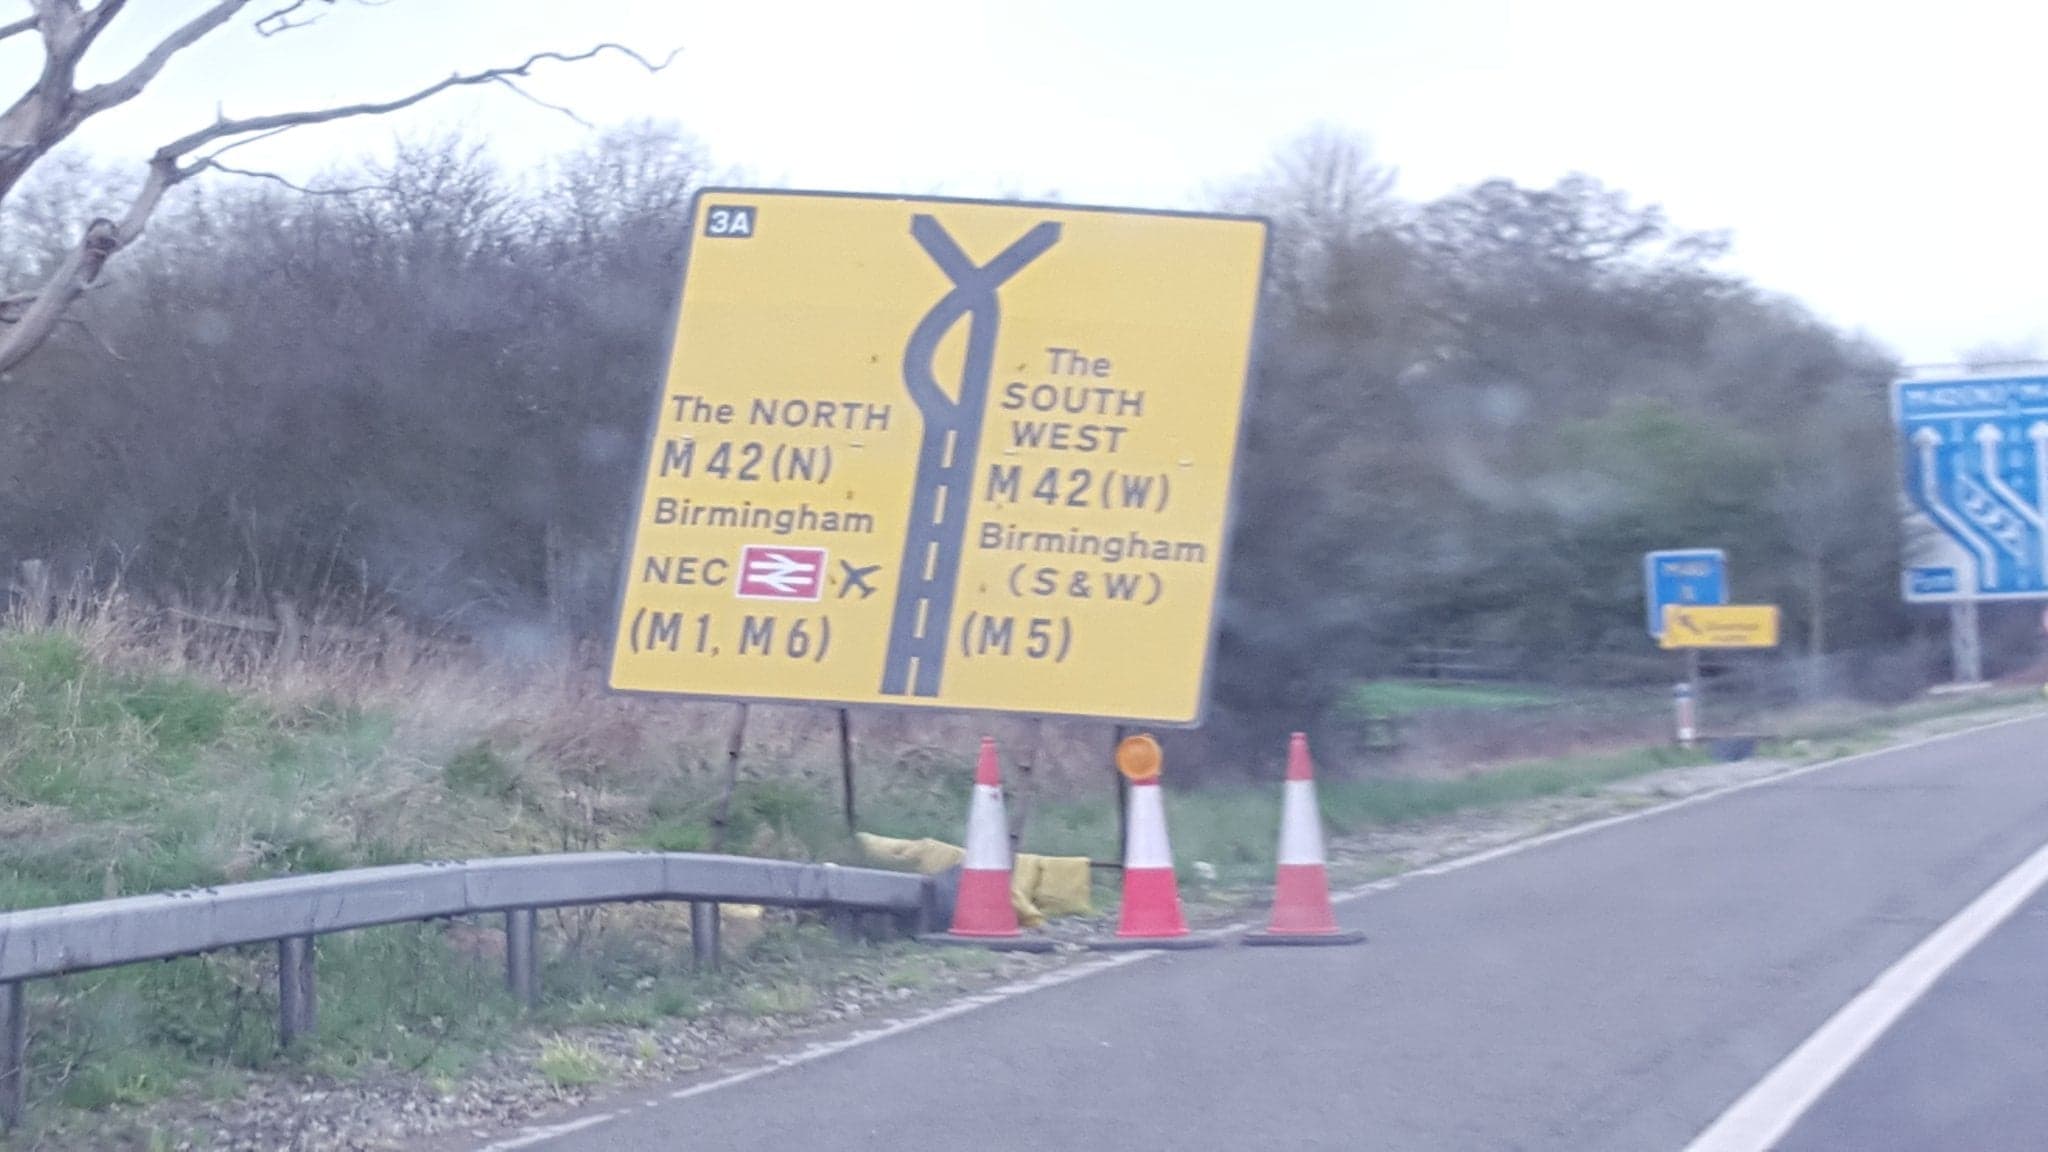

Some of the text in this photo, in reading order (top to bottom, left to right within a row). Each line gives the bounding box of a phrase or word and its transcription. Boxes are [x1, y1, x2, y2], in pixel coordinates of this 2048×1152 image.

[710, 210, 749, 234] 3A
[1046, 347, 1111, 378] The
[672, 395, 891, 431] The NORTH
[1001, 382, 1145, 417] SOUTH
[1011, 420, 1128, 453] WEST
[654, 497, 874, 535] Birmingham
[979, 521, 1207, 564] Birmingham
[643, 556, 729, 586] NEC
